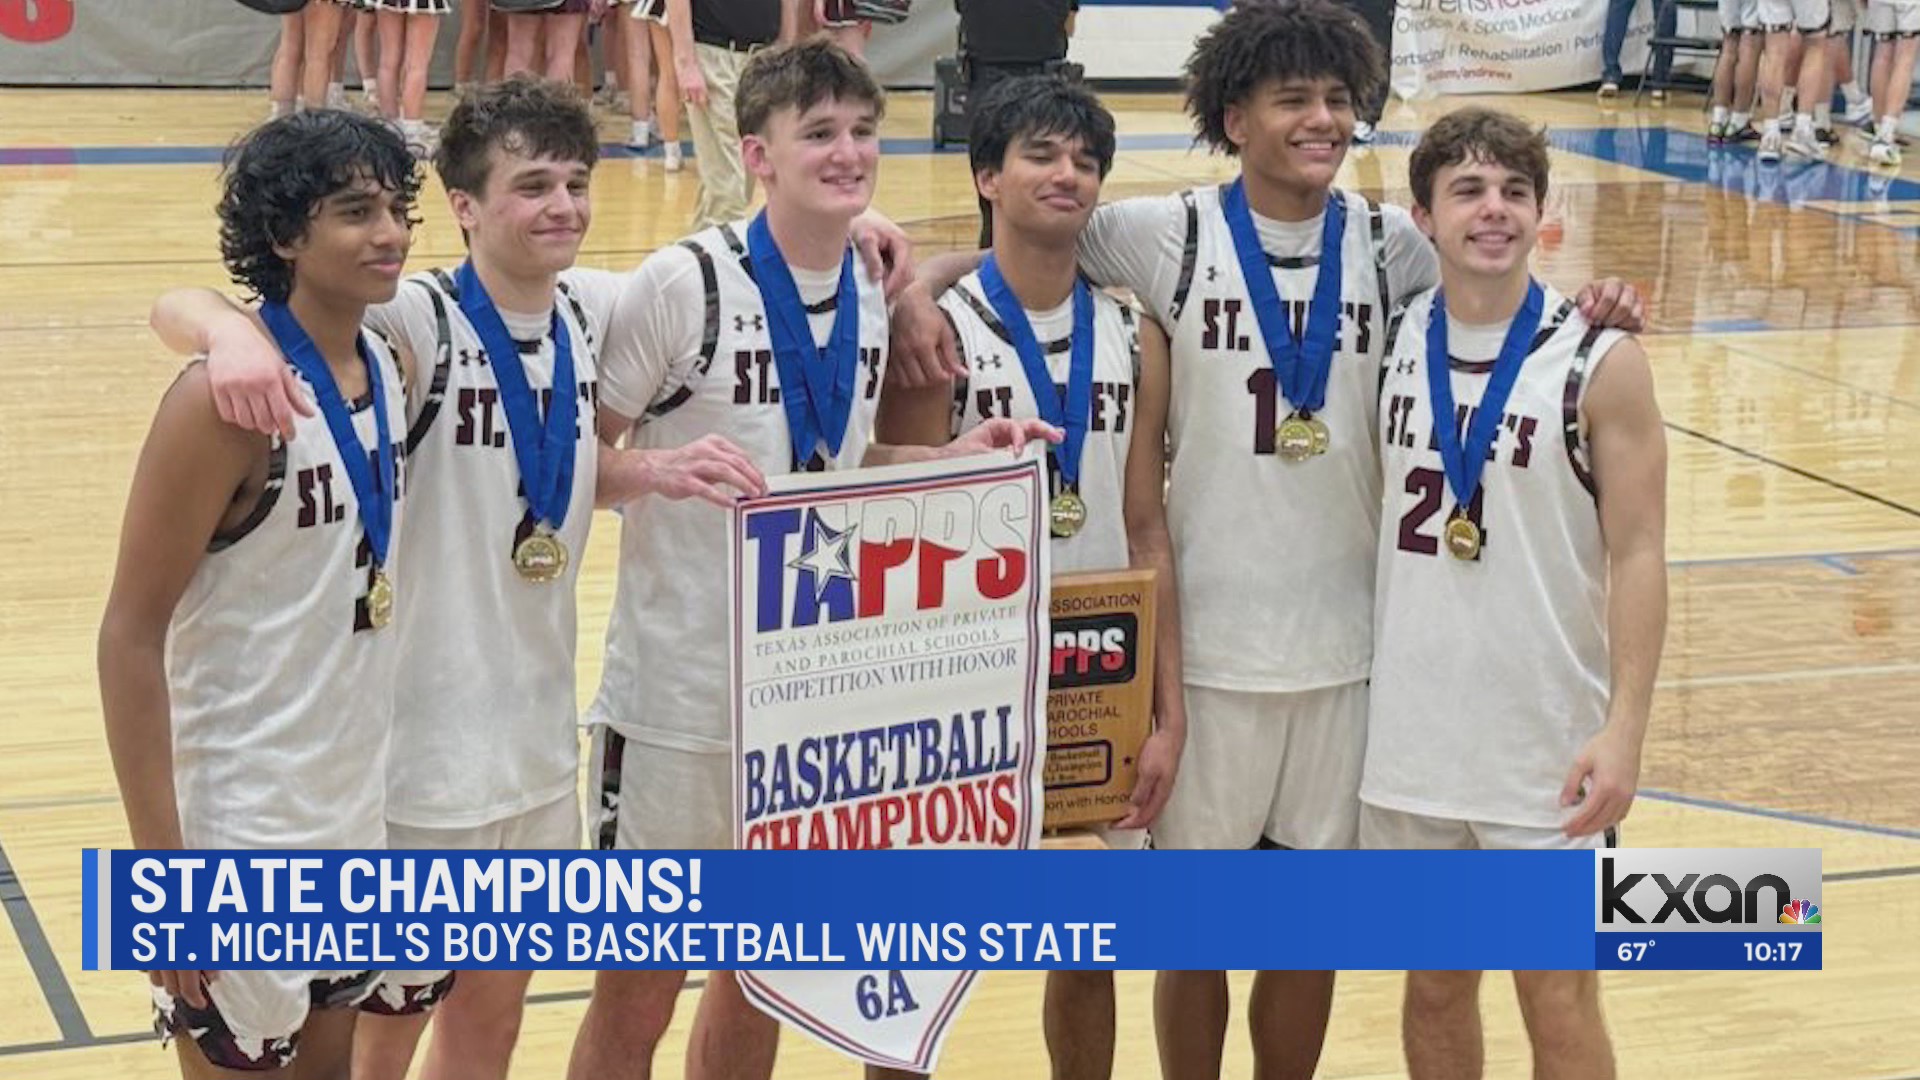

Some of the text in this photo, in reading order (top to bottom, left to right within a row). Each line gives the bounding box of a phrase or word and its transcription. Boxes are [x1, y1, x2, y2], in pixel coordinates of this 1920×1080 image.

[1459, 42, 1562, 63] Rehabilitation
[1202, 299, 1249, 351] ST.
[733, 350, 780, 404] ST.
[456, 388, 505, 448] ST.
[1387, 394, 1416, 448] ST.
[297, 463, 345, 528] ST.
[746, 483, 1028, 634] TAPPS
[1051, 593, 1141, 614] SSOCIATION
[755, 605, 1018, 658] TEXAS ASSOCIATION OF PRIVATE
[773, 628, 1001, 675] AND PAROCHIAL SCHOOLS
[1051, 626, 1125, 676] PPS
[749, 648, 1018, 709] COMPETITION WITH HONOR
[1047, 705, 1120, 723] AROCHIAL
[745, 705, 1020, 821] BASKETBALL
[747, 773, 1017, 849] CHAMPIONS
[1066, 795, 1092, 808] with
[855, 970, 919, 1021] 6A
